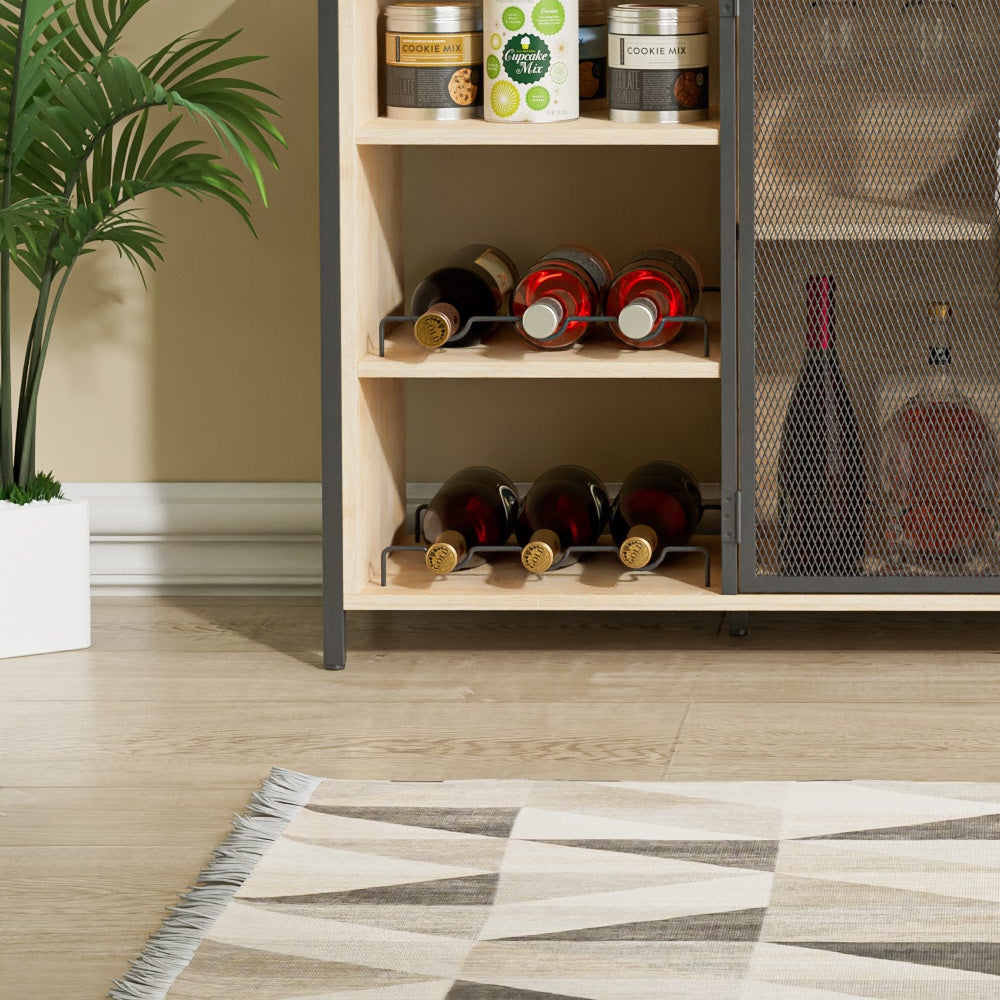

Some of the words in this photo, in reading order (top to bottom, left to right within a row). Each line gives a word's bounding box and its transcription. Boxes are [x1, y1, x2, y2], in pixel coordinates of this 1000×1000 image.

[402, 44, 440, 53] COOKIE
[443, 44, 461, 53] MIX
[504, 48, 548, 65] Cupcake
[627, 46, 665, 55] COOKIE
[668, 46, 687, 55] MIX
[515, 61, 544, 74] Mix
[433, 548, 449, 570] GOLD
[528, 547, 545, 570] GOLD
[627, 542, 643, 565] GOLD
